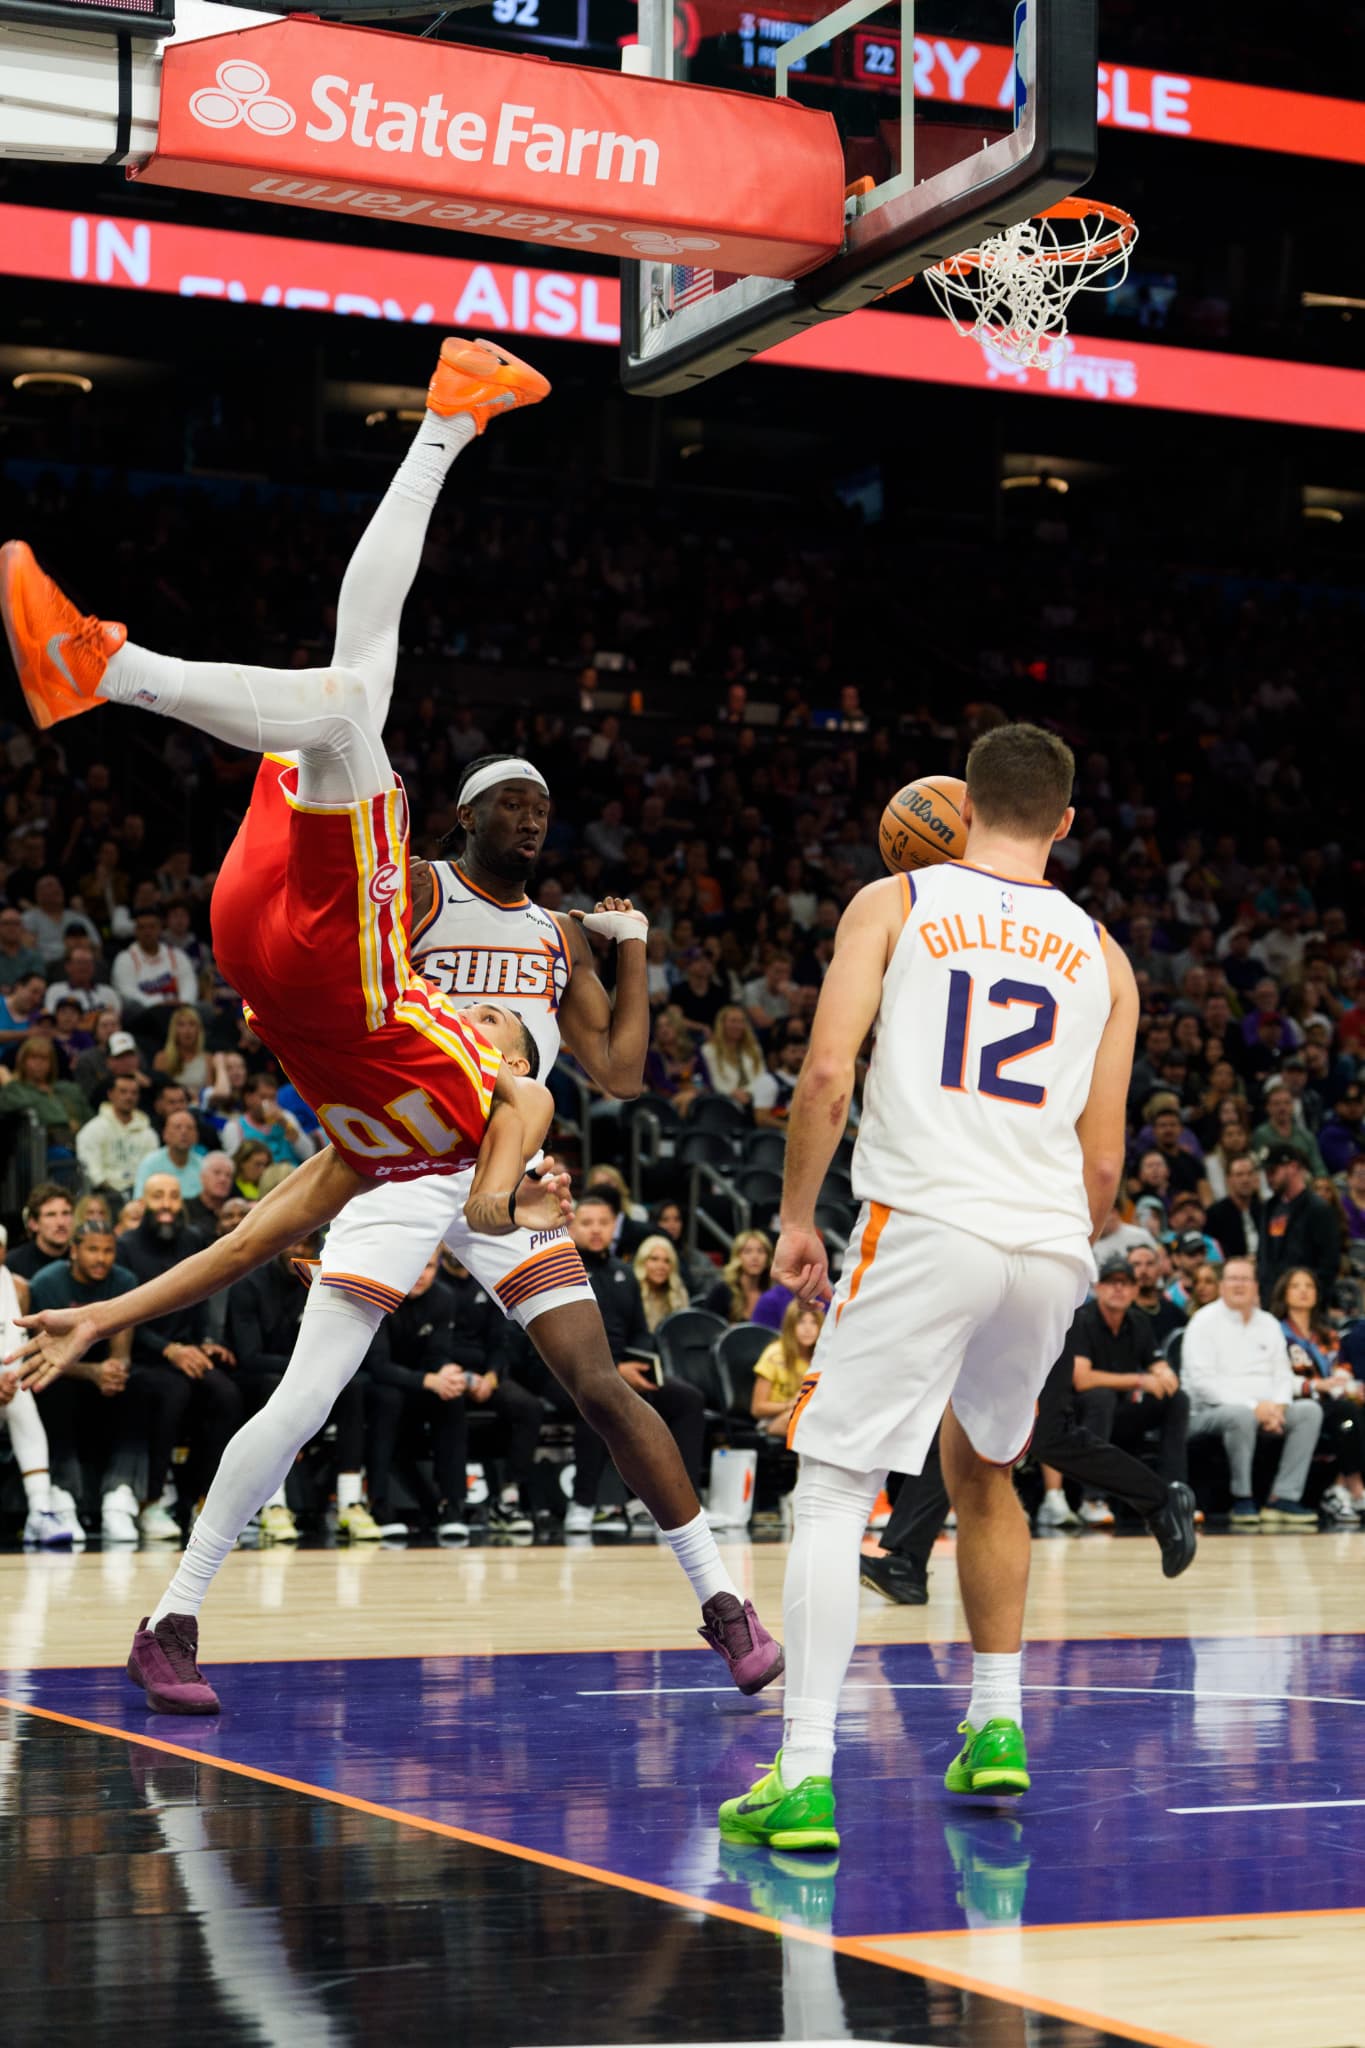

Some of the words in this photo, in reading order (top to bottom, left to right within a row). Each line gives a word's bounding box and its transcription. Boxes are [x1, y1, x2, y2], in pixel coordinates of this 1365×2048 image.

[864, 43, 896, 75] 22
[70, 216, 151, 286] IN
[897, 788, 956, 846] Wilson
[423, 950, 549, 996] SUNS
[918, 913, 1092, 985] GILLESPIE
[940, 967, 1060, 1110] 12
[316, 1087, 463, 1160] 10
